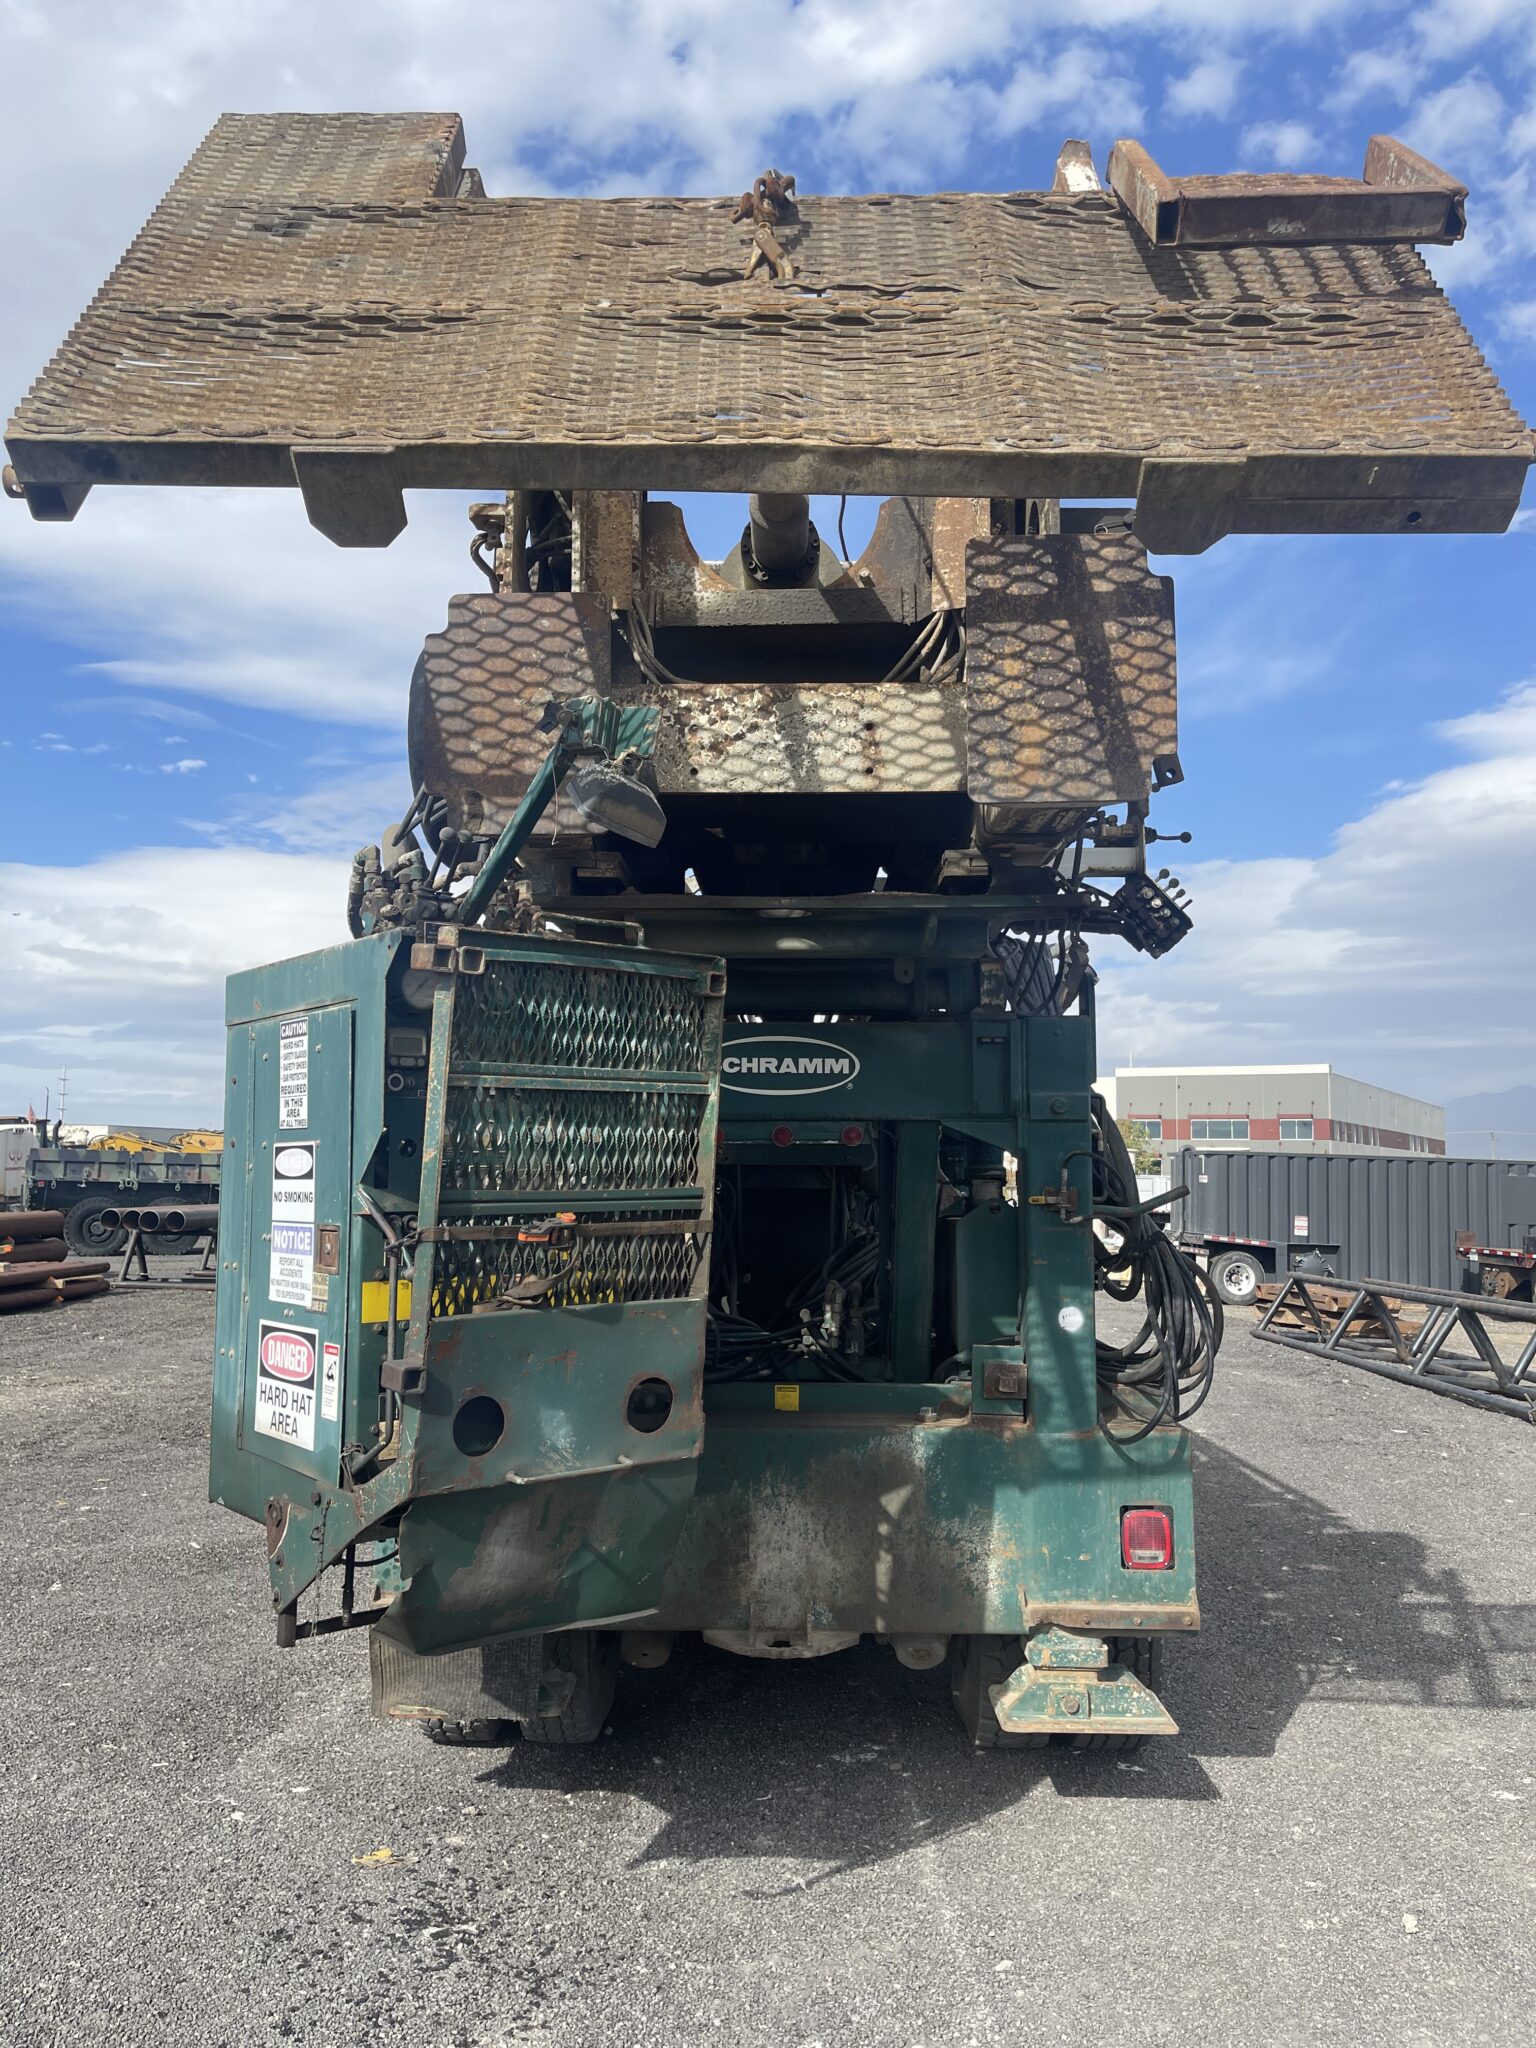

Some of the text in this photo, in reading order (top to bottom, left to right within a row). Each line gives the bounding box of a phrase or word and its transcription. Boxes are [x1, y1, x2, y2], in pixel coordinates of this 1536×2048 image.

[281, 1021, 307, 1037] CAUTION
[283, 1040, 304, 1050] HARD HATS
[720, 1057, 849, 1074] CHRAMM
[281, 1083, 306, 1095] REQUIRED
[284, 1097, 303, 1108] IN THIS
[287, 1108, 300, 1118] AREA
[286, 1119, 294, 1127] ALL
[295, 1118, 306, 1127] TIMES
[274, 1191, 313, 1203] NO SMOKING
[273, 1230, 311, 1251] NOTICE
[279, 1256, 304, 1268] REPORT ALL
[279, 1267, 303, 1279] ACCIDENTS
[281, 1290, 306, 1301] SUPERVISOR
[267, 1338, 308, 1374] DANGER
[259, 1382, 313, 1417] HARD HAT
[270, 1410, 299, 1439] AREA
